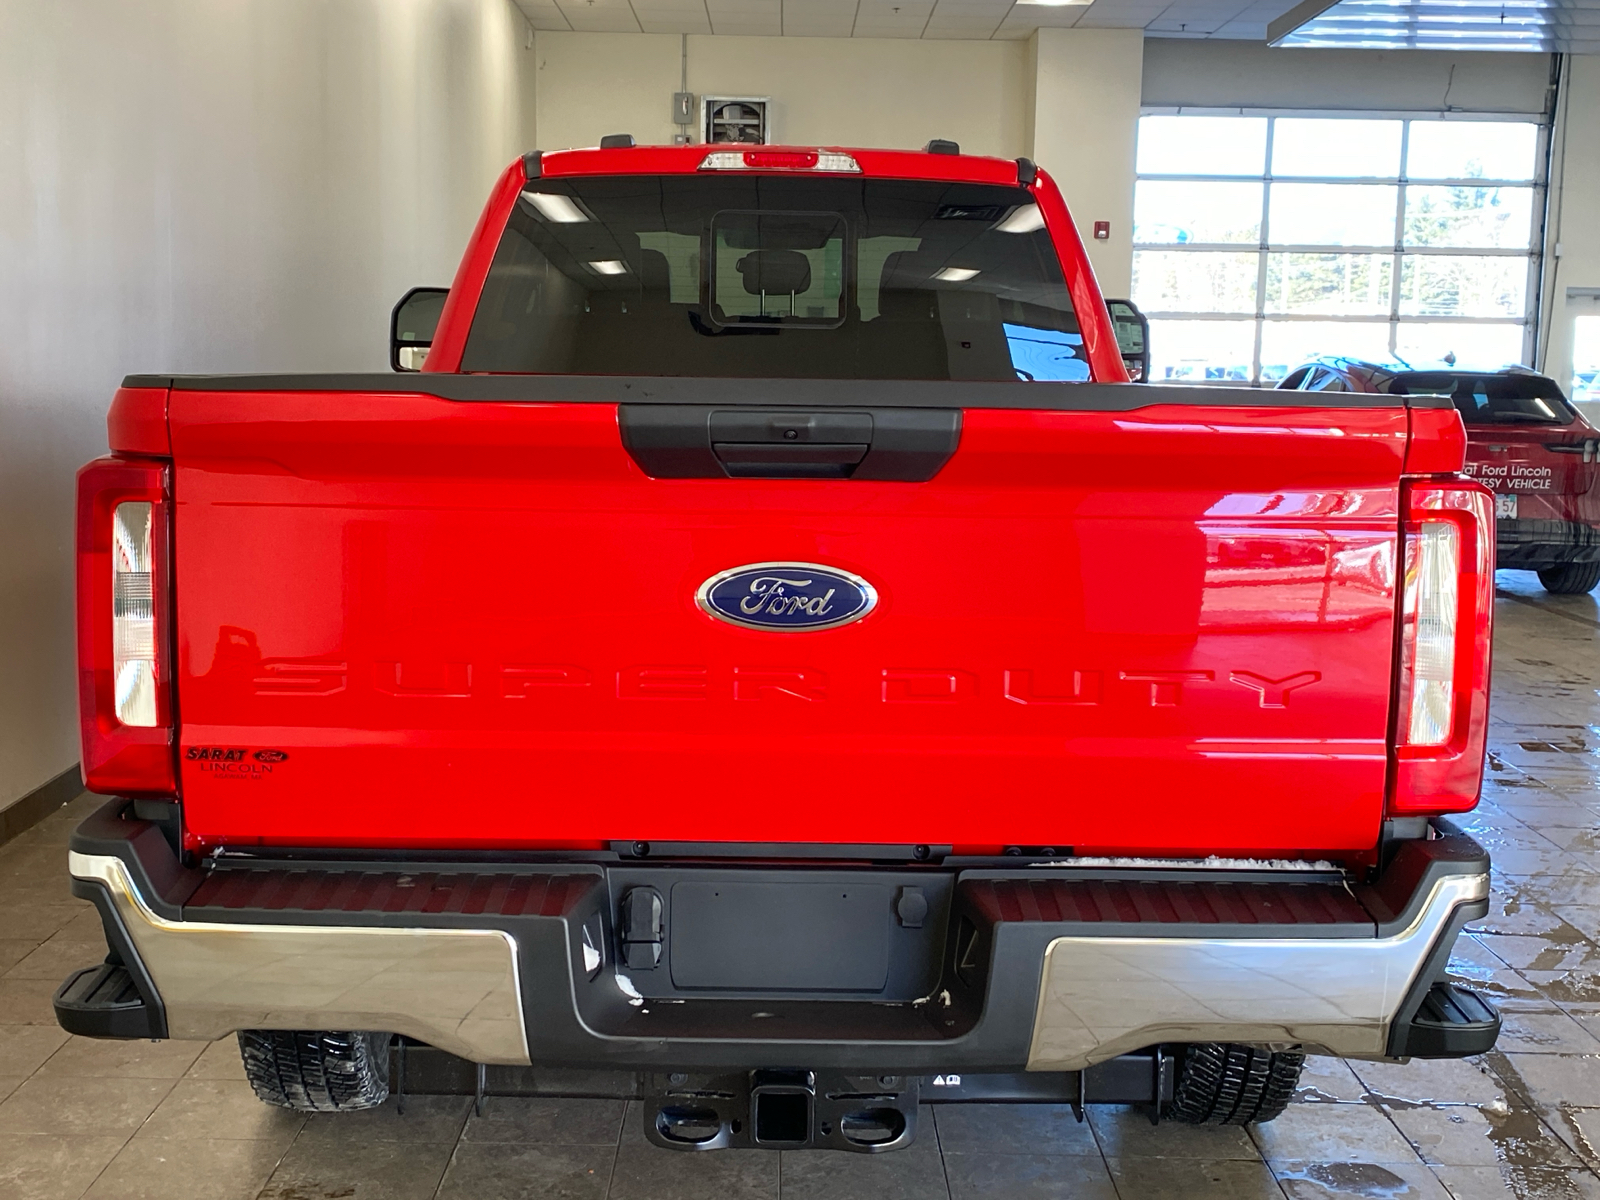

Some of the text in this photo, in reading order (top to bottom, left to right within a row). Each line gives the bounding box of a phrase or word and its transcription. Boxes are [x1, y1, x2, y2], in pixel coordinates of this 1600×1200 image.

[1463, 465, 1551, 477] at Ford Lincoln
[1507, 479, 1552, 489] VEHICLE
[740, 576, 836, 616] Ford
[253, 658, 1322, 709] SUPER DUTY
[185, 747, 248, 761] SARAT
[200, 762, 273, 774] LINCOLN
